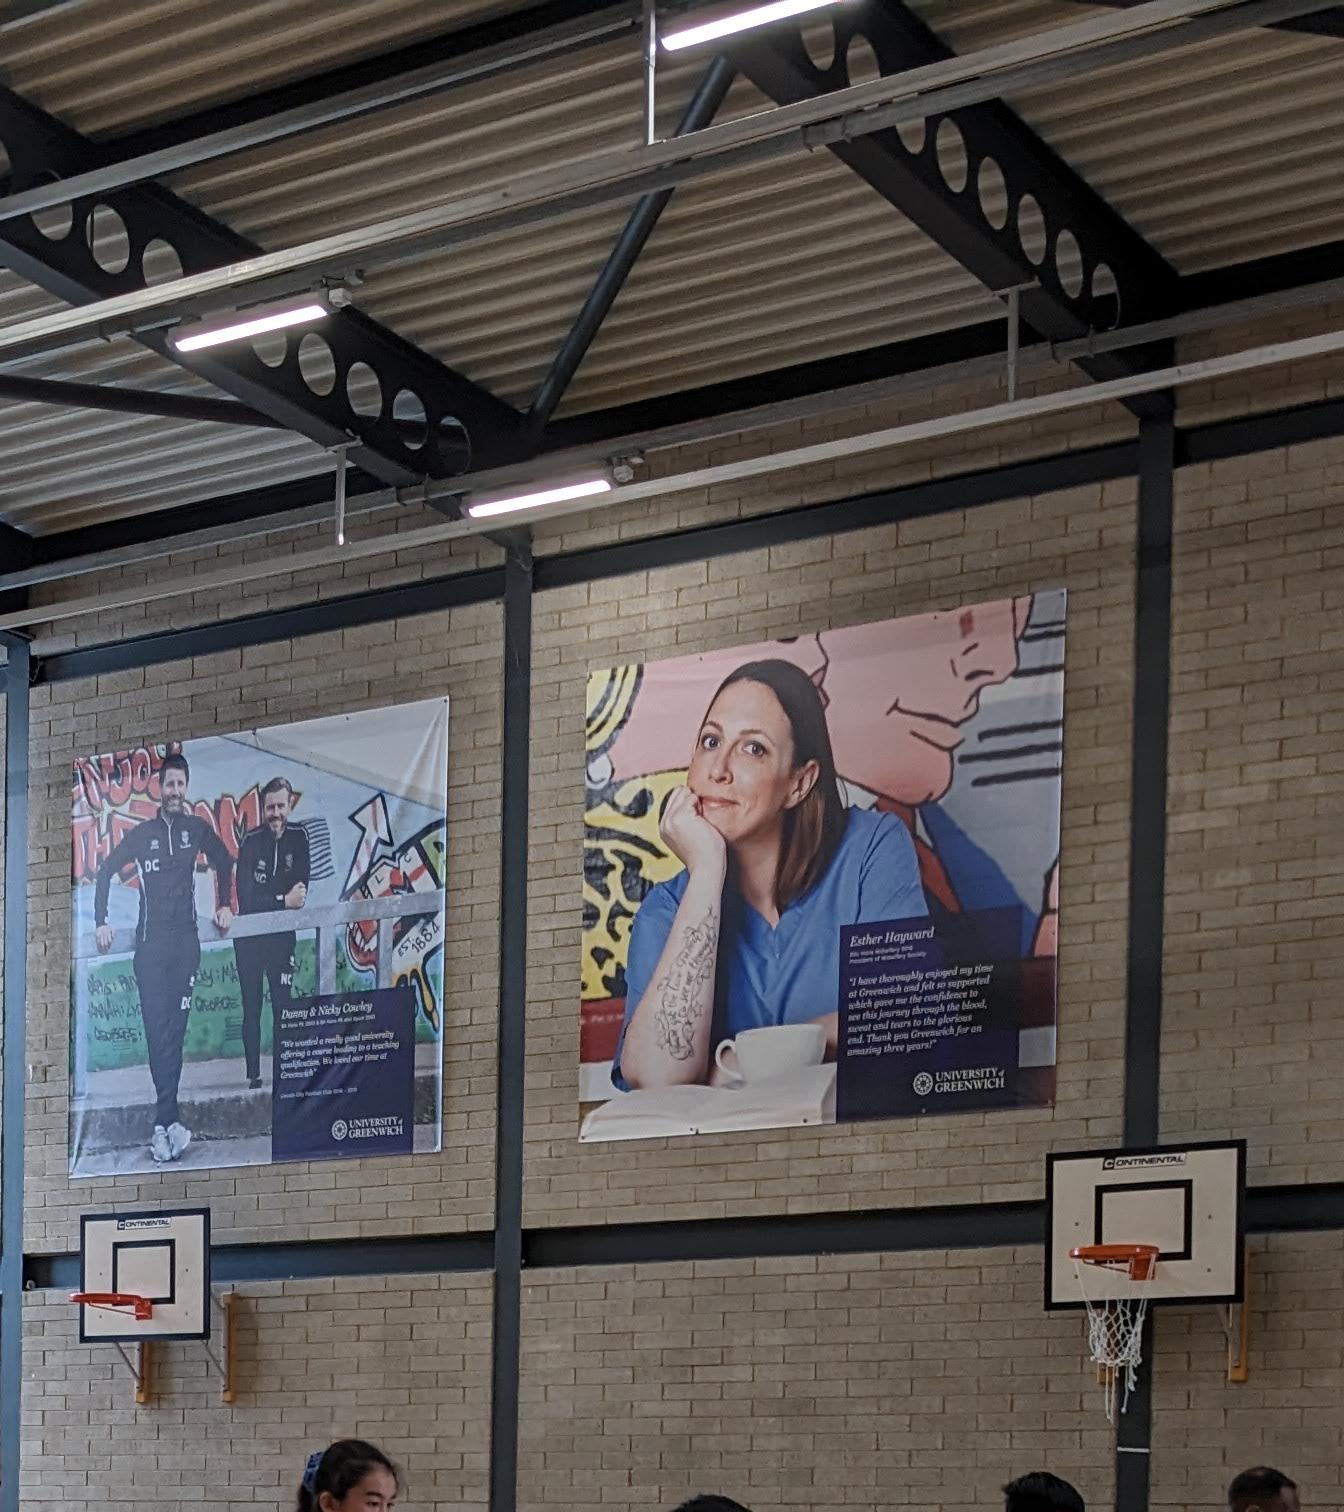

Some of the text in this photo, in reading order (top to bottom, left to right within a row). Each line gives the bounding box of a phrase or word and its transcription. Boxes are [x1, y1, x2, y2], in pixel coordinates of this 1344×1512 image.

[145, 859, 160, 873] DC
[850, 926, 935, 948] Esther Hayward
[280, 973, 292, 985] NC
[858, 975, 877, 986] have
[879, 970, 924, 985] thoroughly
[925, 966, 958, 980] enjoyed
[974, 963, 994, 974] time
[858, 984, 902, 998] Greenwich
[903, 982, 919, 993] and
[920, 980, 935, 993] felt
[947, 975, 991, 990] supported
[848, 998, 873, 1010] which
[874, 998, 894, 1009] gave
[909, 994, 922, 1004] the
[923, 991, 968, 1003] confidence
[969, 989, 979, 998] to
[281, 1001, 373, 1021] Danny & Nicky Cowley
[862, 1010, 877, 1020] this
[878, 1007, 910, 1021] journey
[912, 1004, 945, 1016] through
[946, 1002, 960, 1012] the
[847, 1013, 973, 1034] sweat and tears to the glorious
[295, 1037, 318, 1047] wanted
[325, 1034, 344, 1045] really
[344, 1033, 360, 1043] good
[361, 1030, 395, 1041] university
[866, 1032, 892, 1043] Thank
[893, 1033, 909, 1043] you
[910, 1027, 954, 1039] Greenwich
[955, 1025, 970, 1037] for
[970, 1024, 983, 1033] an
[333, 1044, 358, 1054] leading
[358, 1043, 366, 1051] to
[371, 1041, 400, 1051] teaching
[847, 1045, 882, 1057] amazing
[883, 1042, 905, 1053] three
[322, 1056, 333, 1065] We
[334, 1054, 351, 1064] loved
[364, 1053, 379, 1062] time
[935, 1067, 998, 1082] UNIVERSITY
[935, 1077, 1005, 1093] GREENWICH
[349, 1117, 399, 1129] UNIVERSITY
[348, 1125, 404, 1139] GREENWICH
[1104, 1156, 1185, 1169] CONTINENTAL
[117, 1219, 171, 1230] CONTINENTAL
